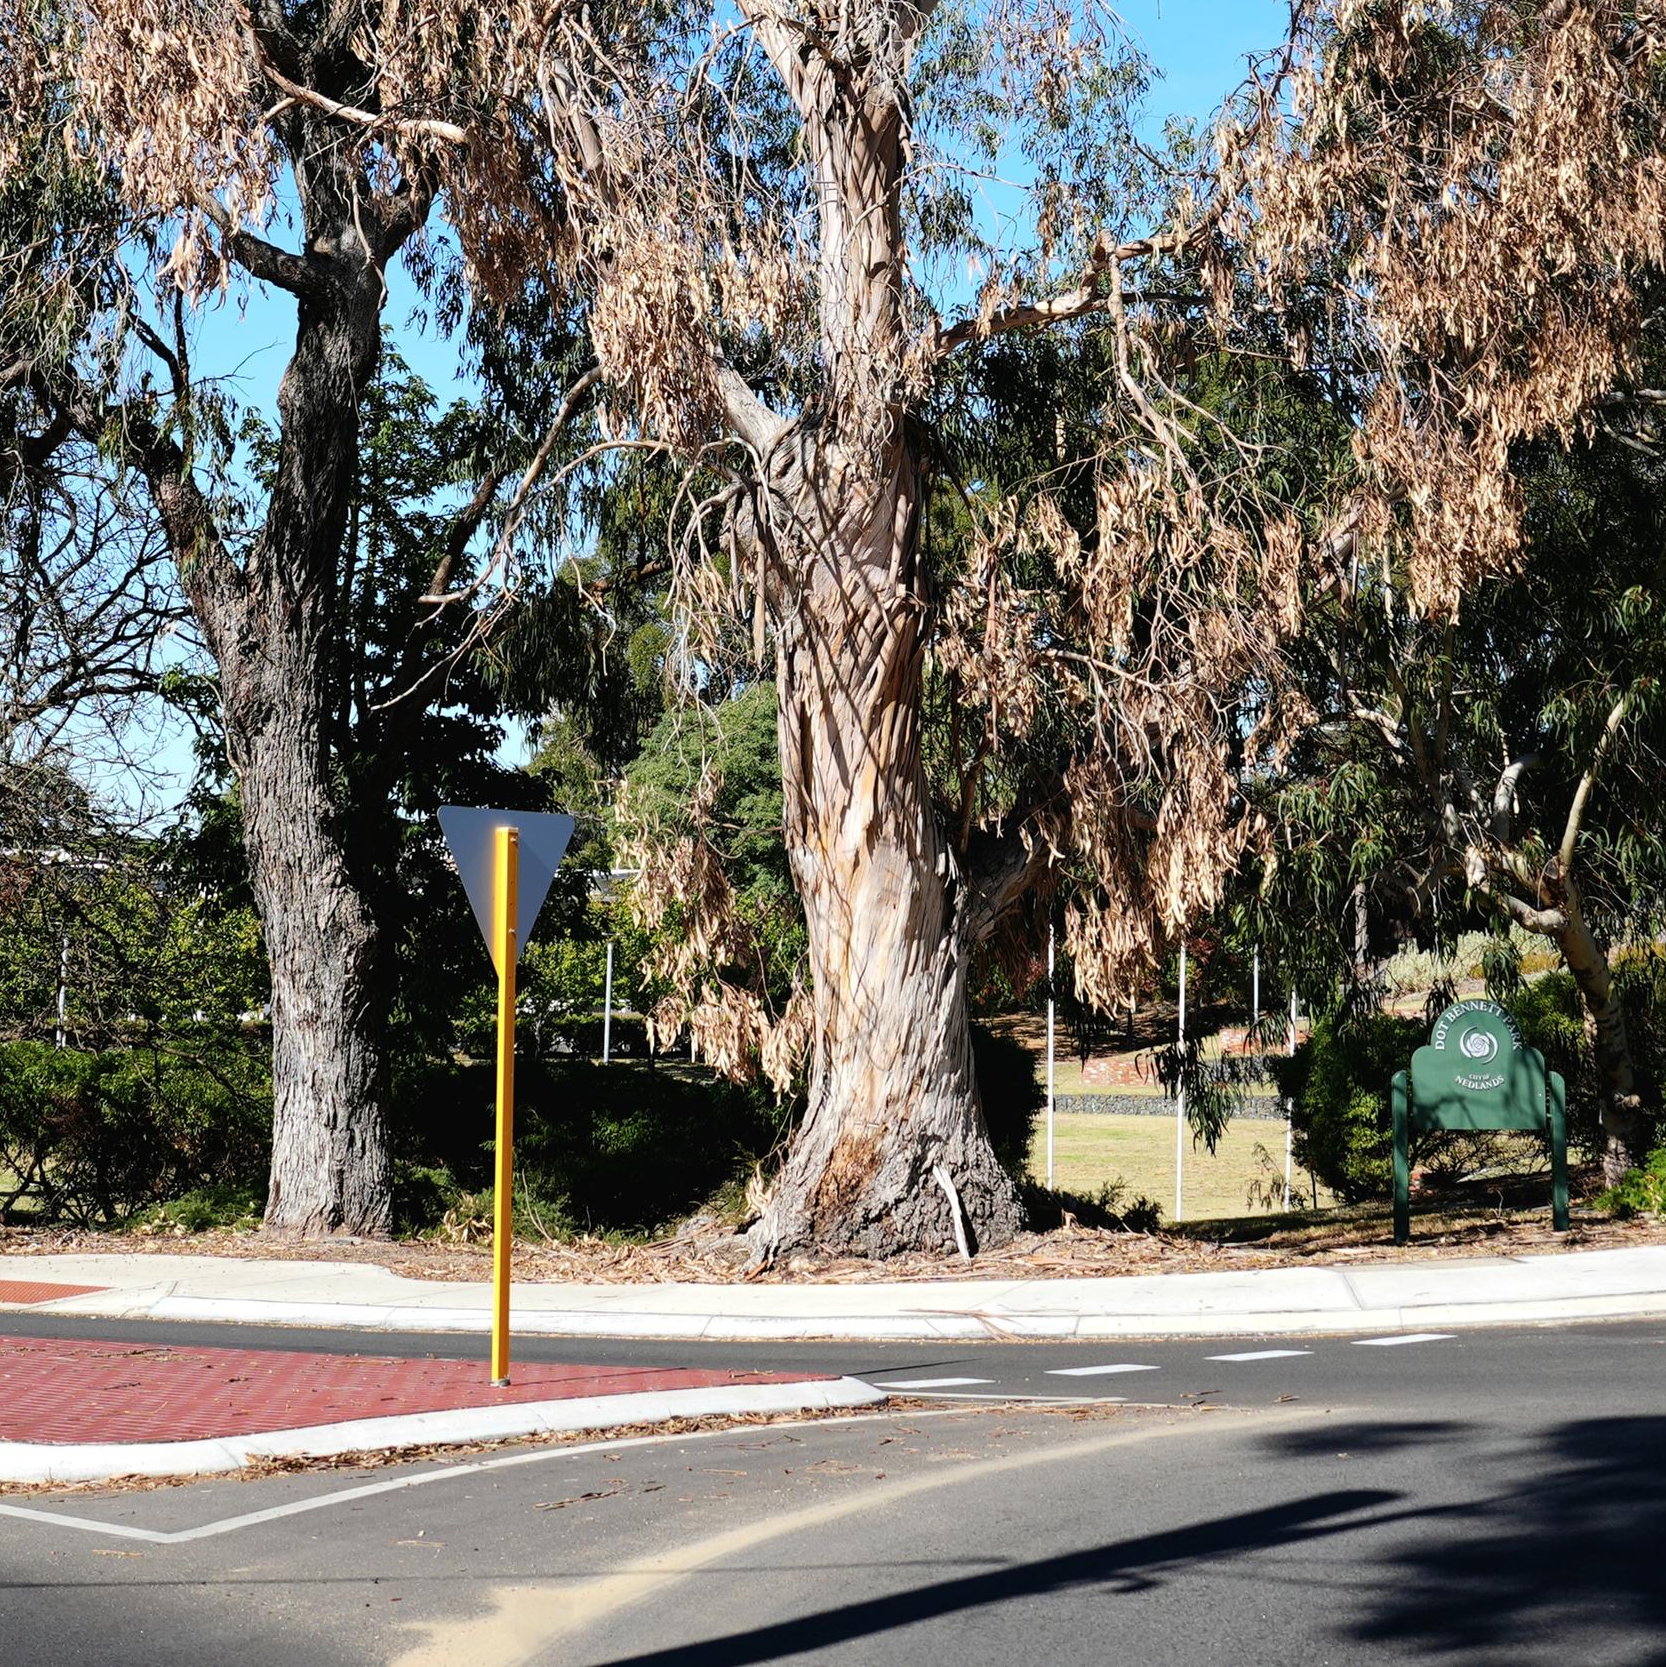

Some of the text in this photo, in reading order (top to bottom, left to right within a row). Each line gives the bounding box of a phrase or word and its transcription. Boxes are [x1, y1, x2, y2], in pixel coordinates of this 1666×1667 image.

[1435, 1000, 1524, 1050] DOT BENNETT PARK
[1454, 1074, 1506, 1090] NEDLANDS
